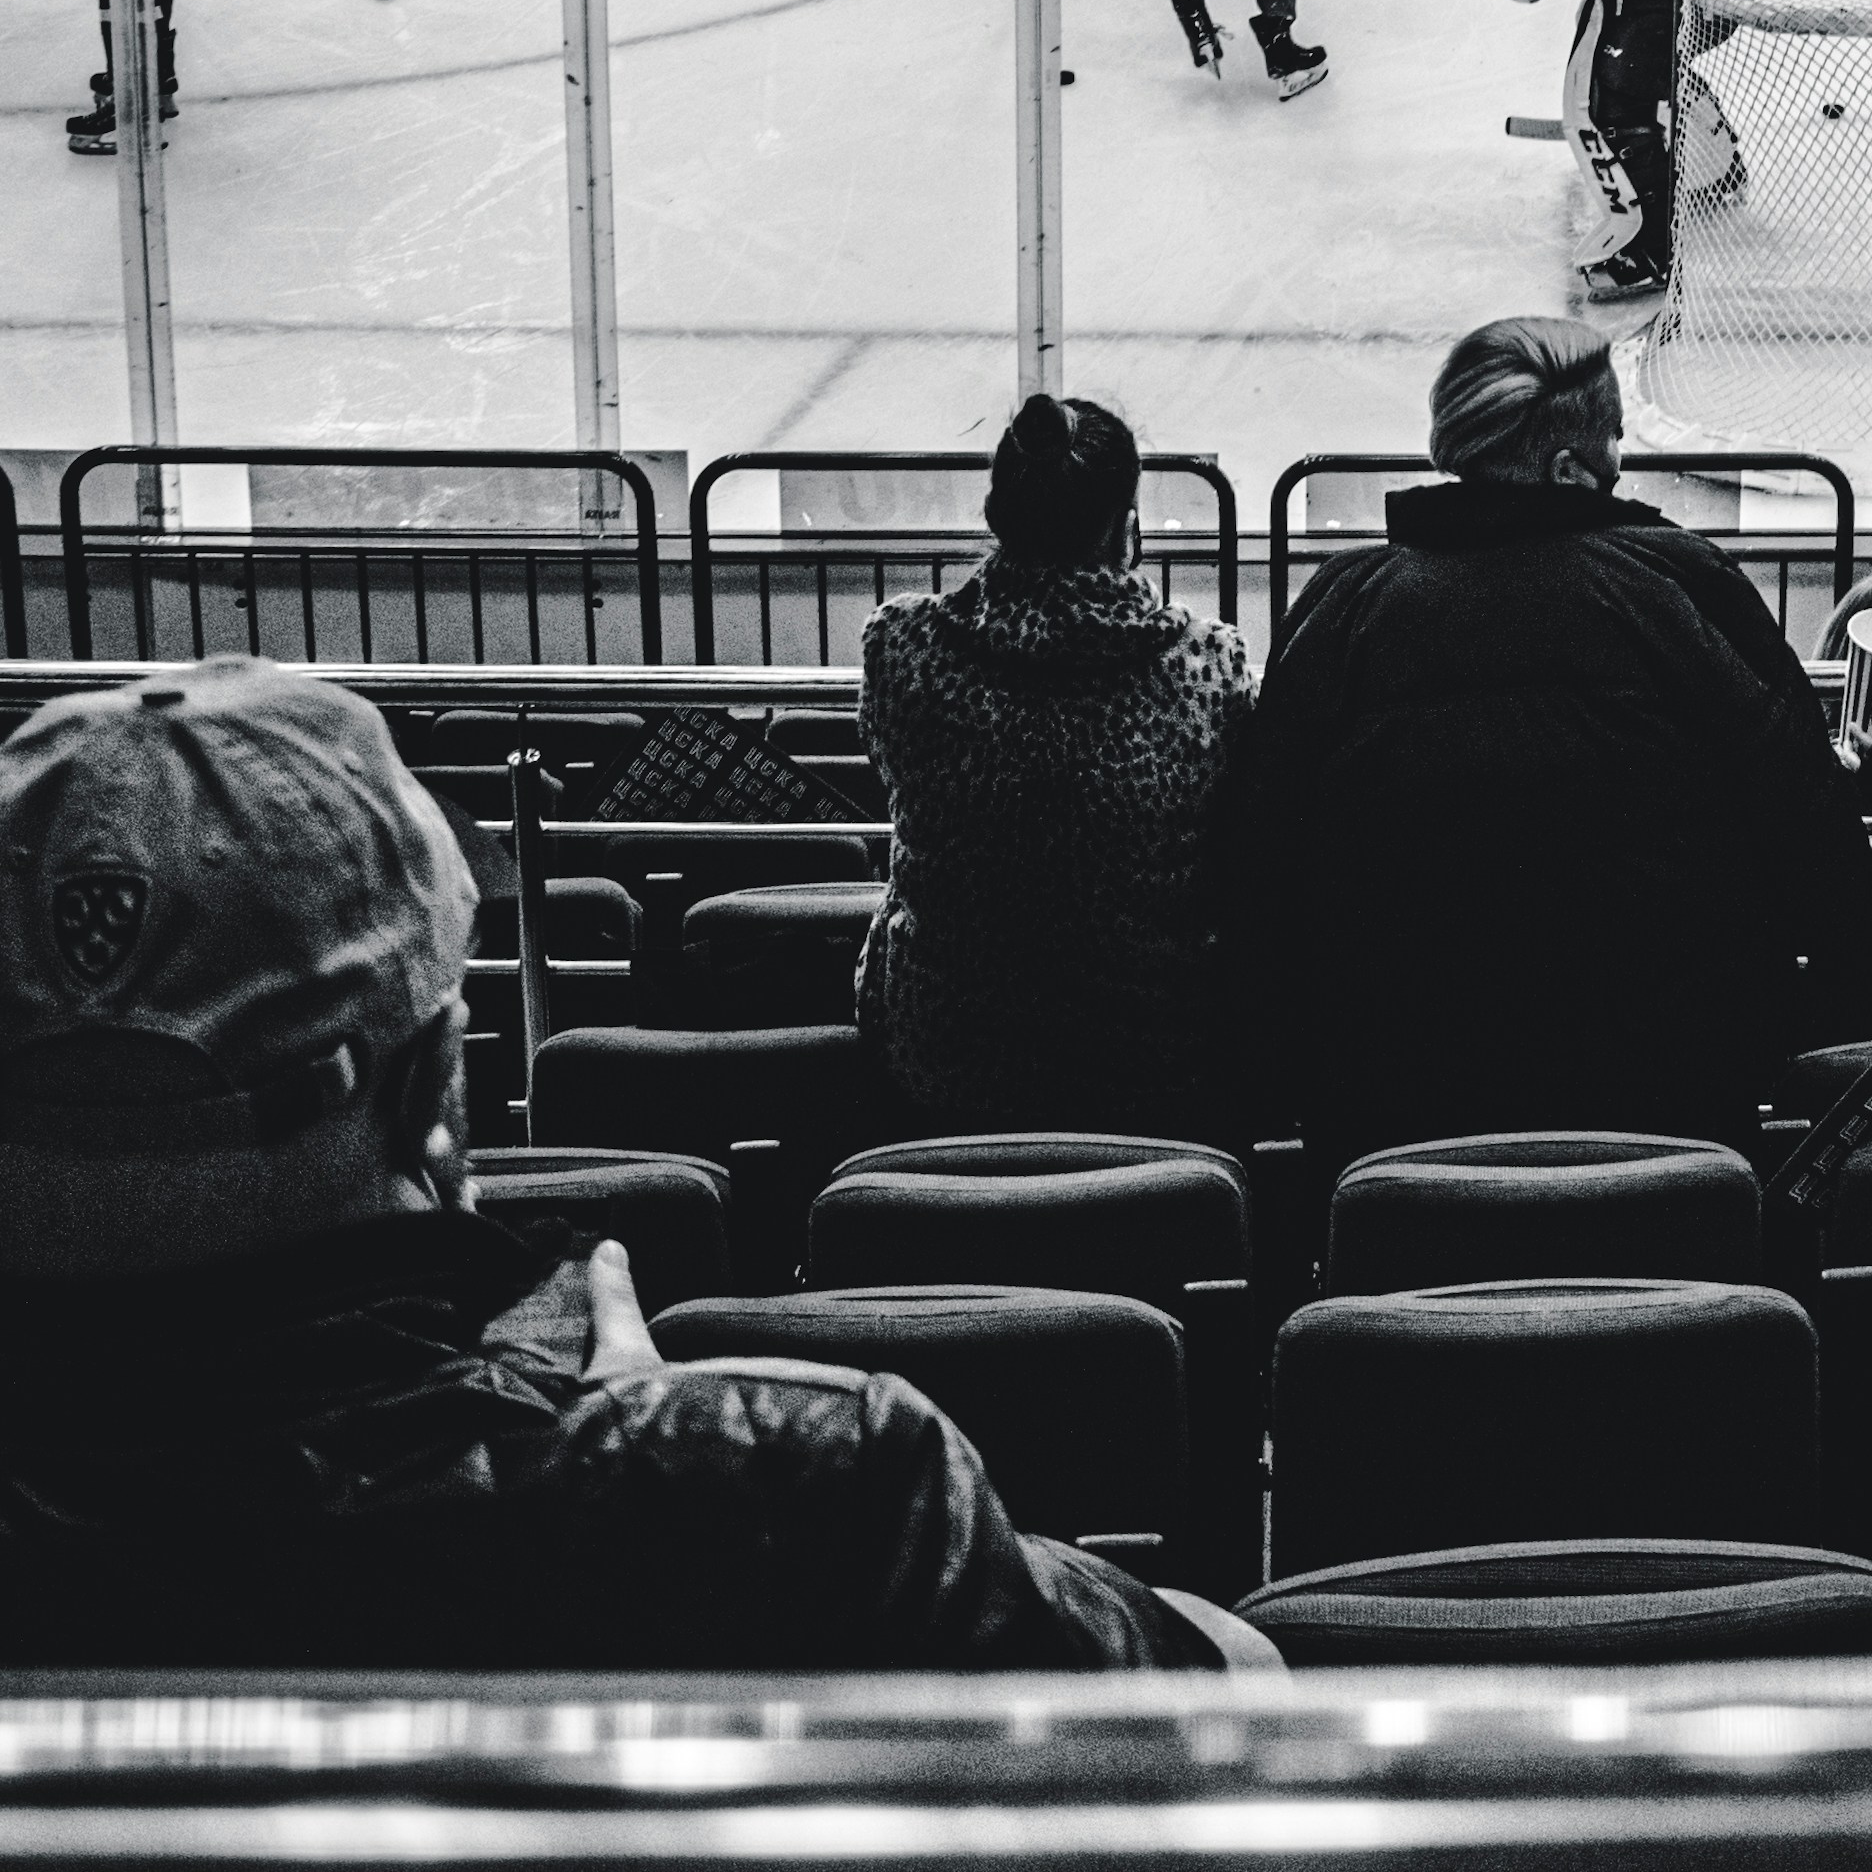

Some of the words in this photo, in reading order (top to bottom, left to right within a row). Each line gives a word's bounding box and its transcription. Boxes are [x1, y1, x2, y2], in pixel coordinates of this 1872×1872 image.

[642, 739, 708, 788] ЦСКА
[658, 719, 723, 770] ЦСКА
[627, 758, 693, 808] ЦСКА
[729, 766, 793, 818] ЦСКА
[744, 745, 807, 799] ЦСКА
